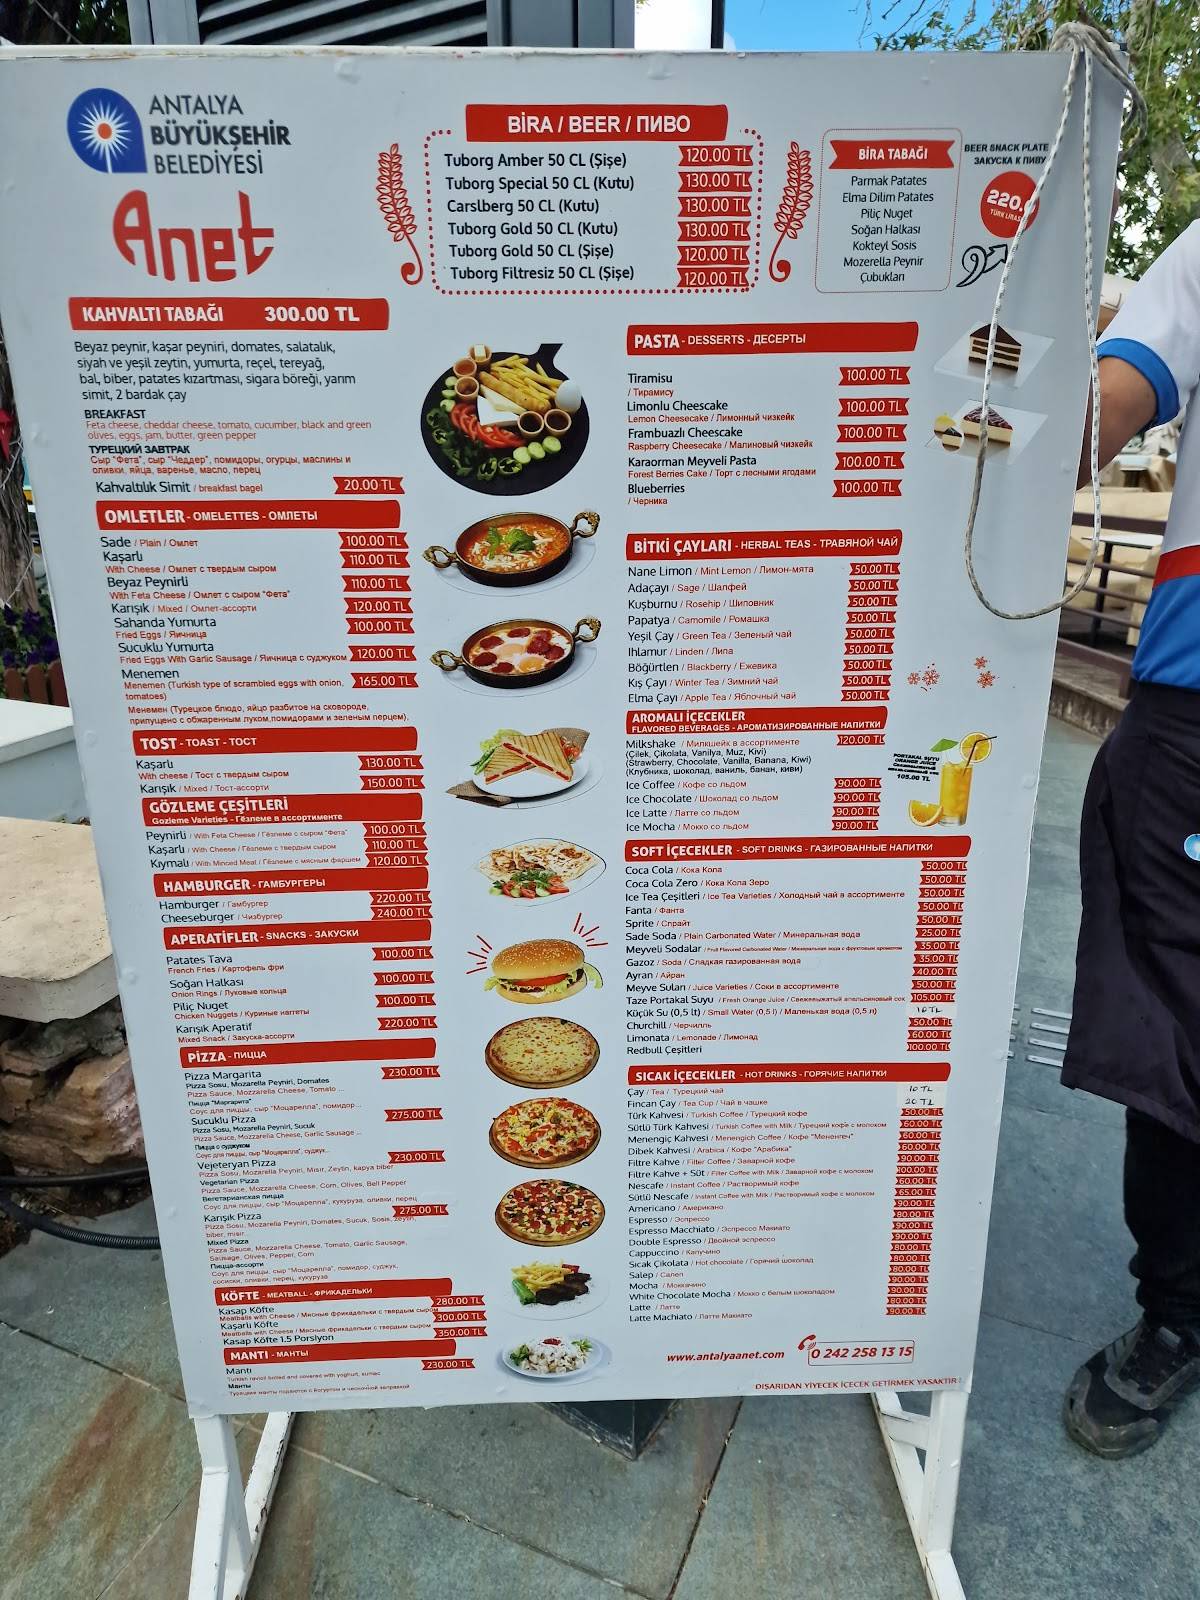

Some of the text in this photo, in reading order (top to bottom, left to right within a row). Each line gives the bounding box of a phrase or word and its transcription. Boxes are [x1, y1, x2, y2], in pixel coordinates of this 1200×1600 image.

[149, 96, 243, 114] ANTALYA
[508, 112, 691, 133] BİRA BEER ПИВО
[151, 120, 291, 150] BÜYÜKŞEHİR
[687, 148, 749, 162] 120.00 TL
[859, 146, 928, 160] BİRA TABAĞI
[155, 150, 263, 174] BELEDİYESİ
[445, 152, 626, 171] Tuborg Amber 50 CL (Şişe)
[446, 176, 634, 193] Tuborg Special 50 CL (Kutu)
[851, 176, 927, 186] Parmak Patates
[448, 198, 599, 216] Carslberg 50 CL (Kutu)
[861, 208, 912, 220] Piliç Nuget
[113, 190, 274, 282] Anet
[844, 256, 923, 267] Mozerella Peynir
[450, 266, 634, 282] Tuborg Filtresiz 50 CL (Şişe)
[860, 272, 905, 283] Çubukları
[83, 303, 223, 322] KAHVALTI TABAĞI
[265, 307, 359, 321] 300.00 TL
[634, 334, 806, 348] PASTA DESSERTS ДЕСЕРТЫ
[75, 341, 335, 355] Beyaz peynir, kaşar peyniri, domates, salatalık,
[628, 373, 672, 383] Tiramisu
[847, 369, 902, 381] 100.00 TL
[627, 400, 728, 411] Limonlu Cheescake
[85, 410, 145, 419] BREAKFAST
[89, 444, 190, 454] ТУРЕЦКИЙ ЗАВТРАК
[628, 456, 756, 468] Karaorman Meyveli Pasta
[96, 481, 190, 493] Kahvaltılık Simit
[344, 480, 395, 491] 20.00 TL
[628, 484, 684, 494] Blueberries
[105, 510, 317, 523] OMLETLER OMELETTES ОМЛЕТЫ
[101, 536, 131, 548] Sade
[346, 536, 401, 547] 100.00 TL
[634, 536, 898, 556] BİTKİ ÇAYLARI HERBAL TEAS ТРАВЯНОЙ ЧАЙ
[106, 565, 160, 573] With Cheese
[628, 566, 692, 576] Nane Limon
[854, 564, 895, 573] 50.00 TL
[107, 577, 188, 589] Beyaz Peynirli
[114, 617, 216, 628] Sahanda Yumurta
[628, 662, 678, 673] Böğürtlen
[122, 669, 179, 679] Menemen
[632, 710, 745, 724] AROMALI İÇECEKLER
[140, 737, 256, 749] TOST TOAST ТОСТ
[626, 739, 676, 749] Milkshake
[626, 780, 675, 789] Ice Coffee
[150, 796, 288, 815] GÖZLEME ÇEŞİTLERİ
[191, 816, 228, 824] Varieties
[632, 844, 732, 859] SOFT İÇECEKLER
[625, 866, 673, 874] Coca Cola
[163, 878, 325, 892] HAMBURGER ГАМБУРГЕРЫ
[159, 900, 219, 912] Hamburger
[625, 907, 652, 915] Fanta
[162, 912, 234, 924] Cheeseburger
[625, 919, 654, 928] Sprite
[171, 930, 359, 945] APERATİFLER SNACKS ЗАКУСКИ
[166, 954, 232, 965] Patates Tava
[188, 1050, 267, 1063] PİZZA ПИЦЦА
[627, 1046, 702, 1056] Redbull Çeşitleri
[184, 1070, 261, 1081] Pizza Margarita
[389, 1068, 436, 1077] 230.00 TL
[635, 1069, 735, 1083] SICAK İÇECEKLER
[198, 1159, 276, 1171] Vejeteryan Pizza
[629, 1203, 675, 1212] Americano
[629, 1249, 679, 1258] Cappuccino
[221, 1290, 259, 1301] KÖFTE
[438, 1329, 482, 1337] 350.00 TL
[230, 1351, 268, 1360] MANTI
[666, 1350, 784, 1362] www.antalyaanet.com
[811, 1347, 912, 1359] 0 242 258 13 15
